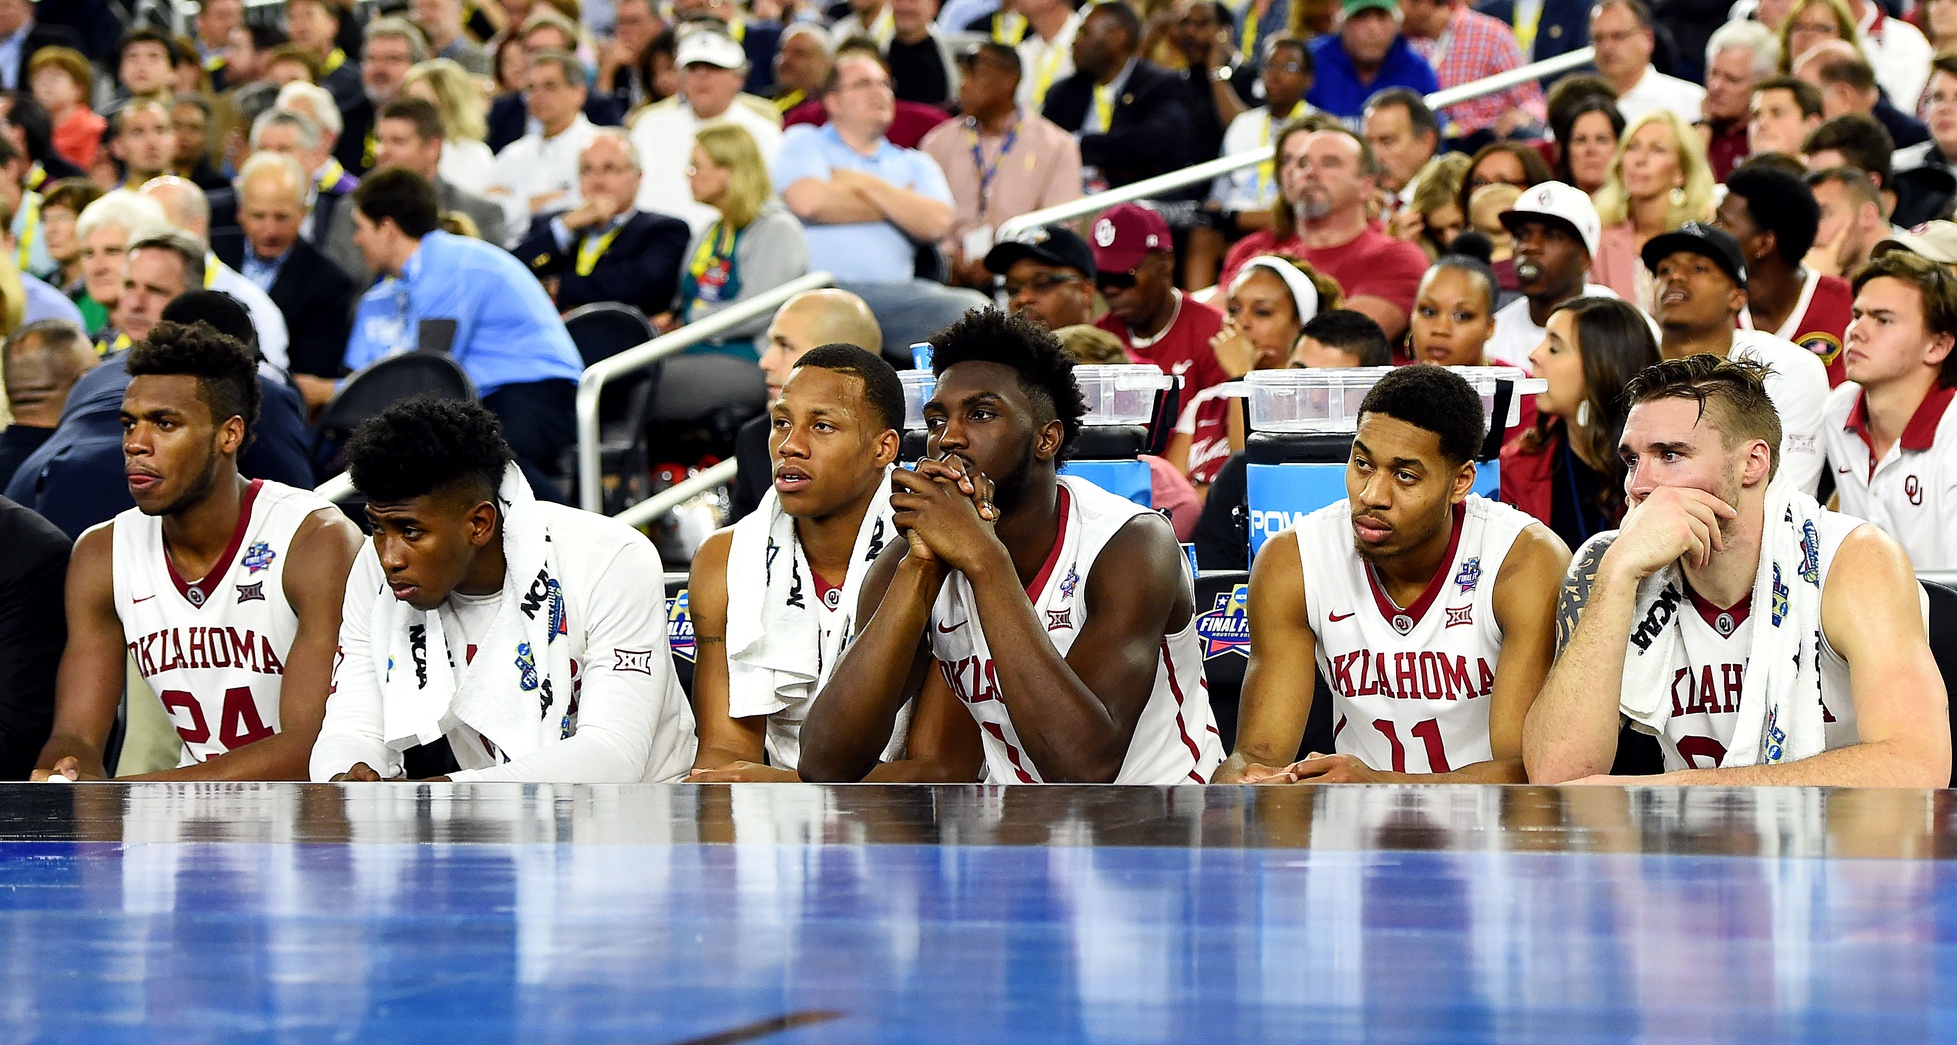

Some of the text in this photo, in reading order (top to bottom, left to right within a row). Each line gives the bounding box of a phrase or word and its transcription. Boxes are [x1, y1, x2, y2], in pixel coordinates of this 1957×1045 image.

[1904, 474, 1923, 506] OU
[1251, 510, 1302, 537] POW
[828, 591, 839, 605] OU
[1200, 617, 1236, 632] FINAL
[1395, 617, 1409, 630] OU
[1631, 581, 1682, 651] NCAA
[1718, 617, 1731, 632] OU
[613, 649, 653, 676] XII
[161, 686, 275, 763] 24
[1372, 717, 1451, 773] 11
